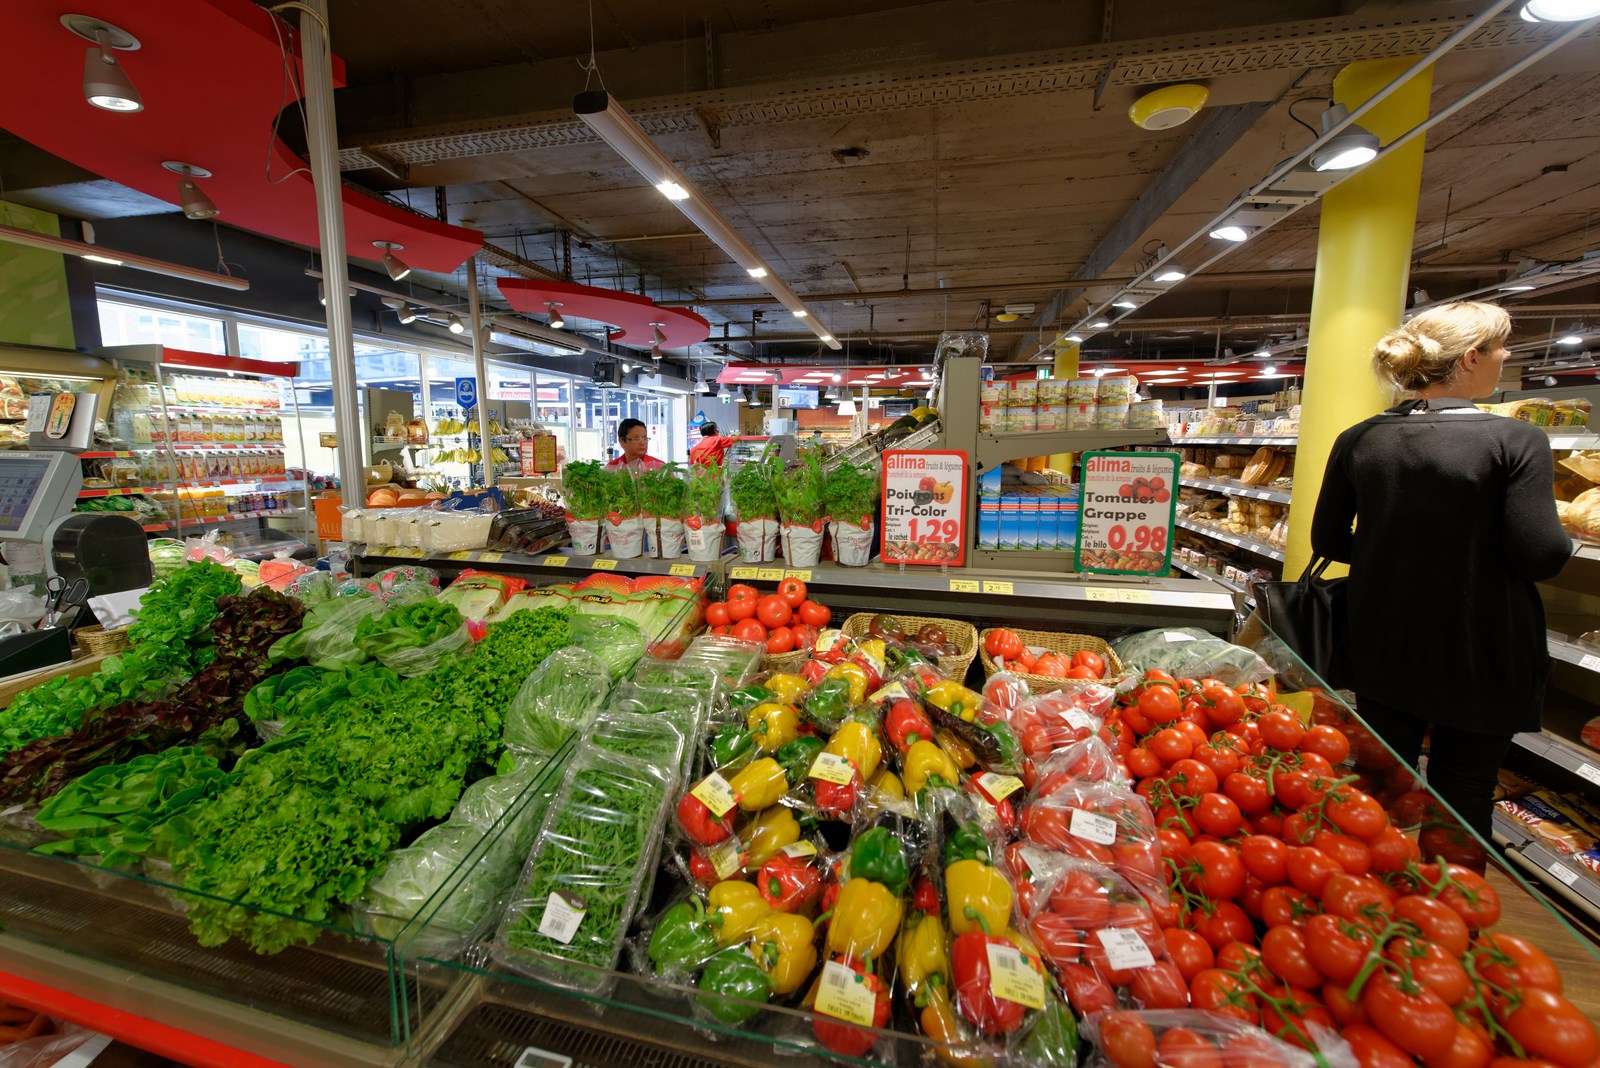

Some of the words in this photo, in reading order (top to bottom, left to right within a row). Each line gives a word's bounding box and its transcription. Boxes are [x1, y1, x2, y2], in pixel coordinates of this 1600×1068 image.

[887, 454, 926, 469] alima
[1086, 457, 1130, 472] alima
[1130, 464, 1146, 473] fruits
[886, 488, 945, 500] Poivrons
[1086, 492, 1155, 504] Tomates
[886, 505, 947, 516] Tri-Color
[1084, 508, 1147, 522] Grappe
[908, 518, 958, 546] 1,29
[1108, 524, 1167, 556] 0,98
